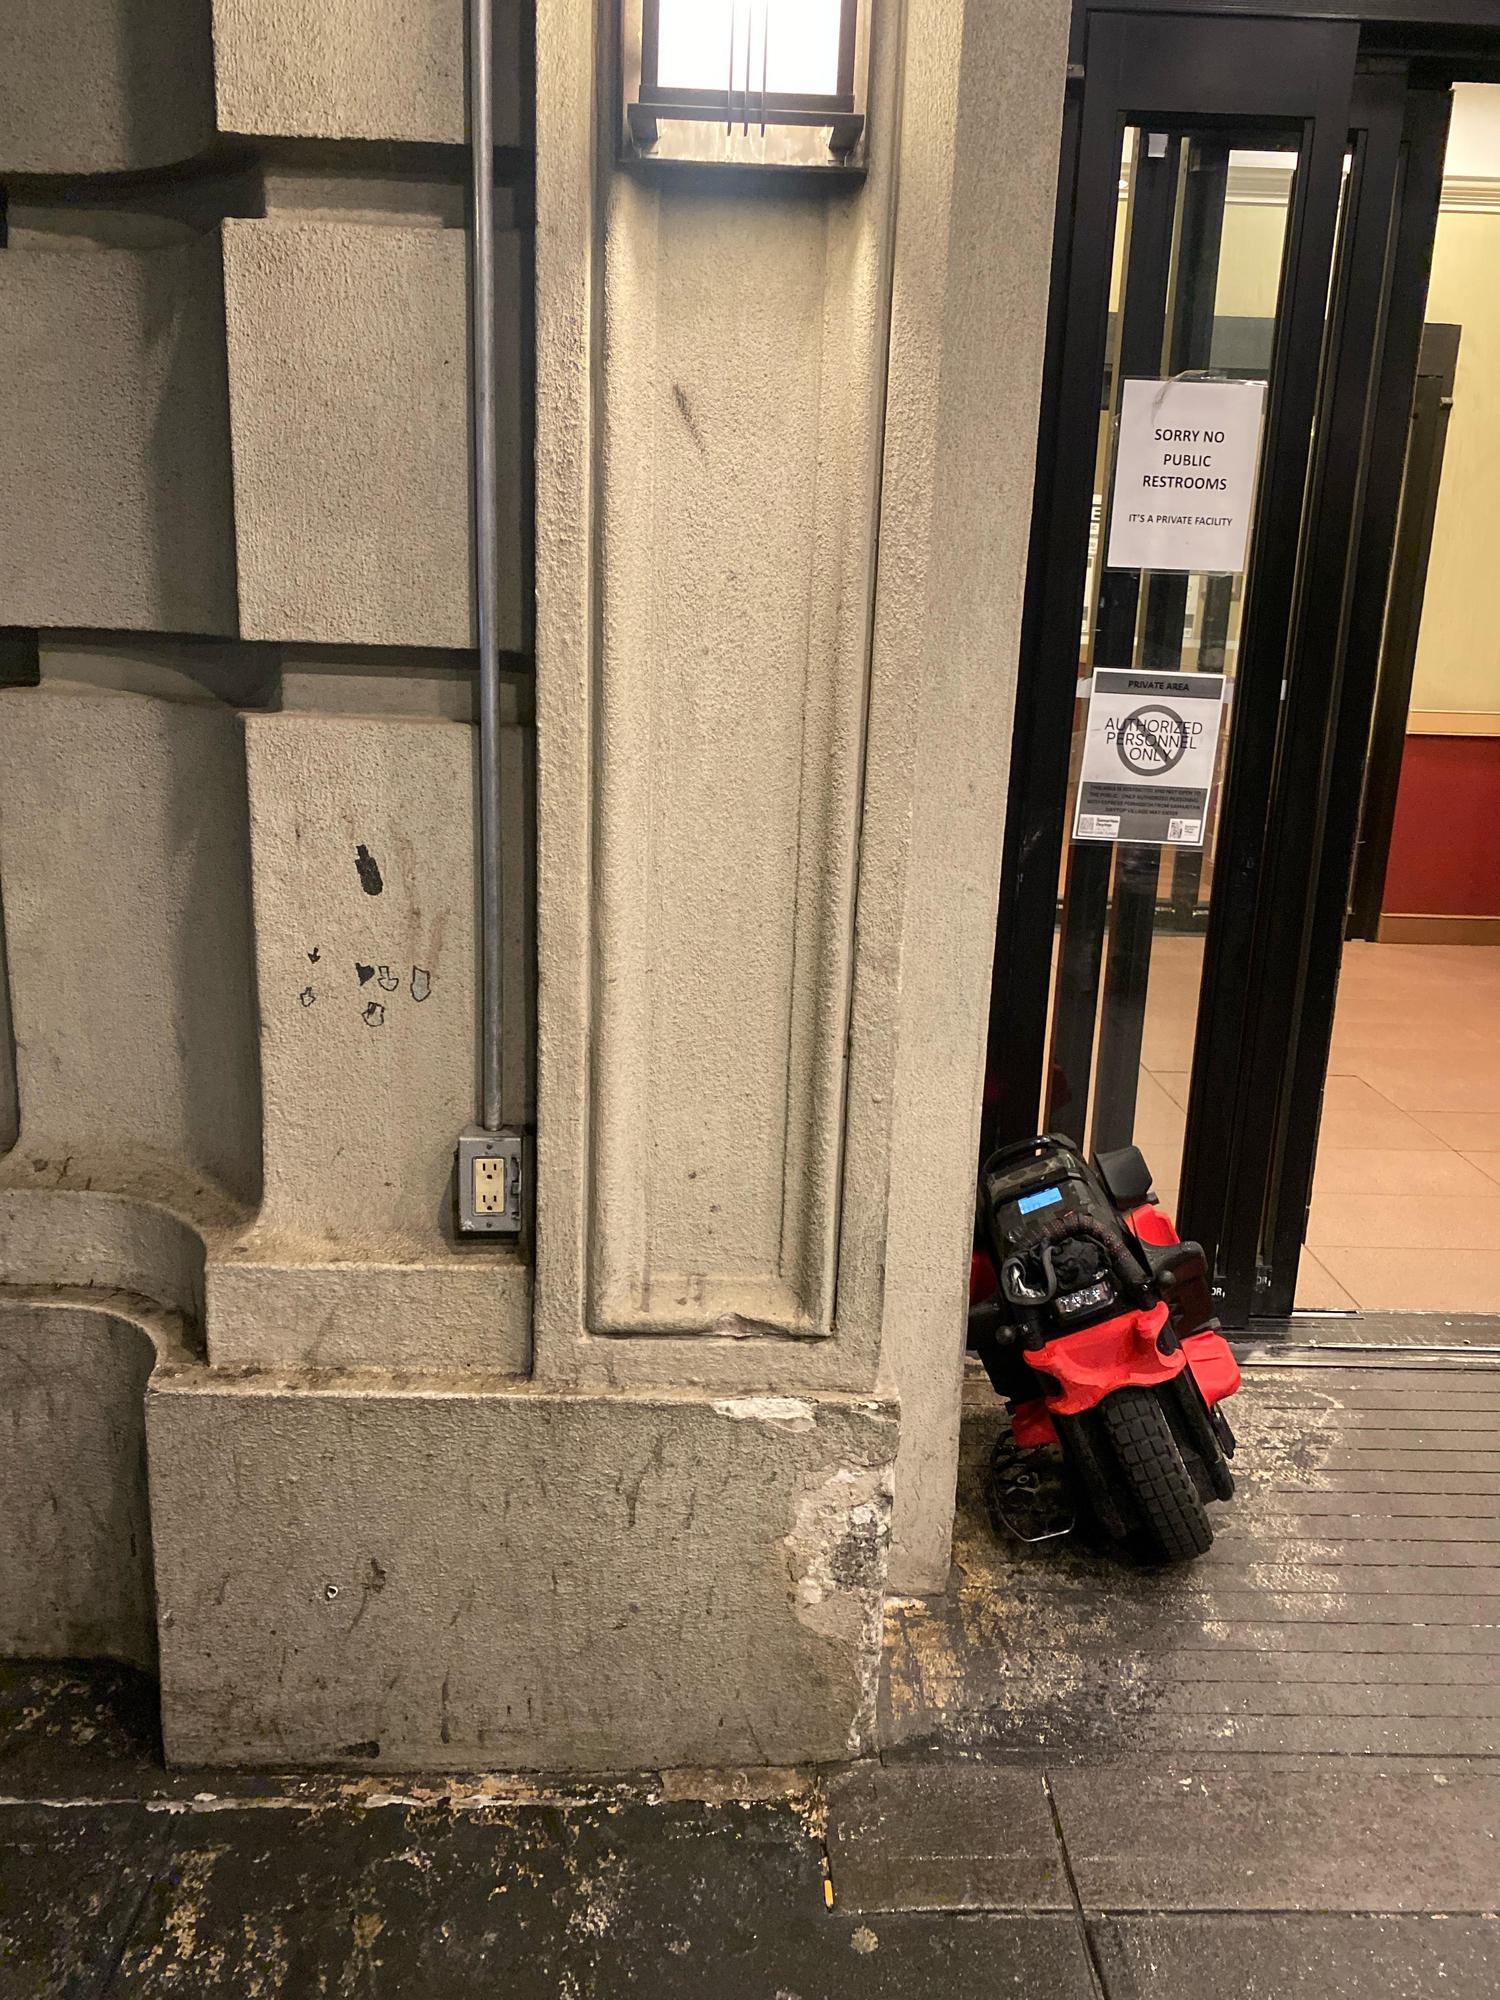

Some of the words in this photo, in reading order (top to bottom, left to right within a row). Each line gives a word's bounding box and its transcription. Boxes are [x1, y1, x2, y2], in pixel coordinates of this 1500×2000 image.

[1154, 428, 1200, 442] SORRY
[1204, 430, 1225, 443] NO
[1163, 453, 1212, 467] PUBLIC
[1142, 475, 1227, 490] RESTROOMS
[1128, 513, 1145, 523] IT'S
[1147, 515, 1154, 523] A
[1156, 515, 1192, 525] PRIVATE
[1195, 516, 1233, 526] FACILITY
[1128, 680, 1165, 690] PRIVATE
[1166, 682, 1190, 692] AREA
[1104, 717, 1203, 735] AUTHORIZED
[1106, 731, 1197, 750] PERSONNEL
[1129, 747, 1173, 762] ONLY
